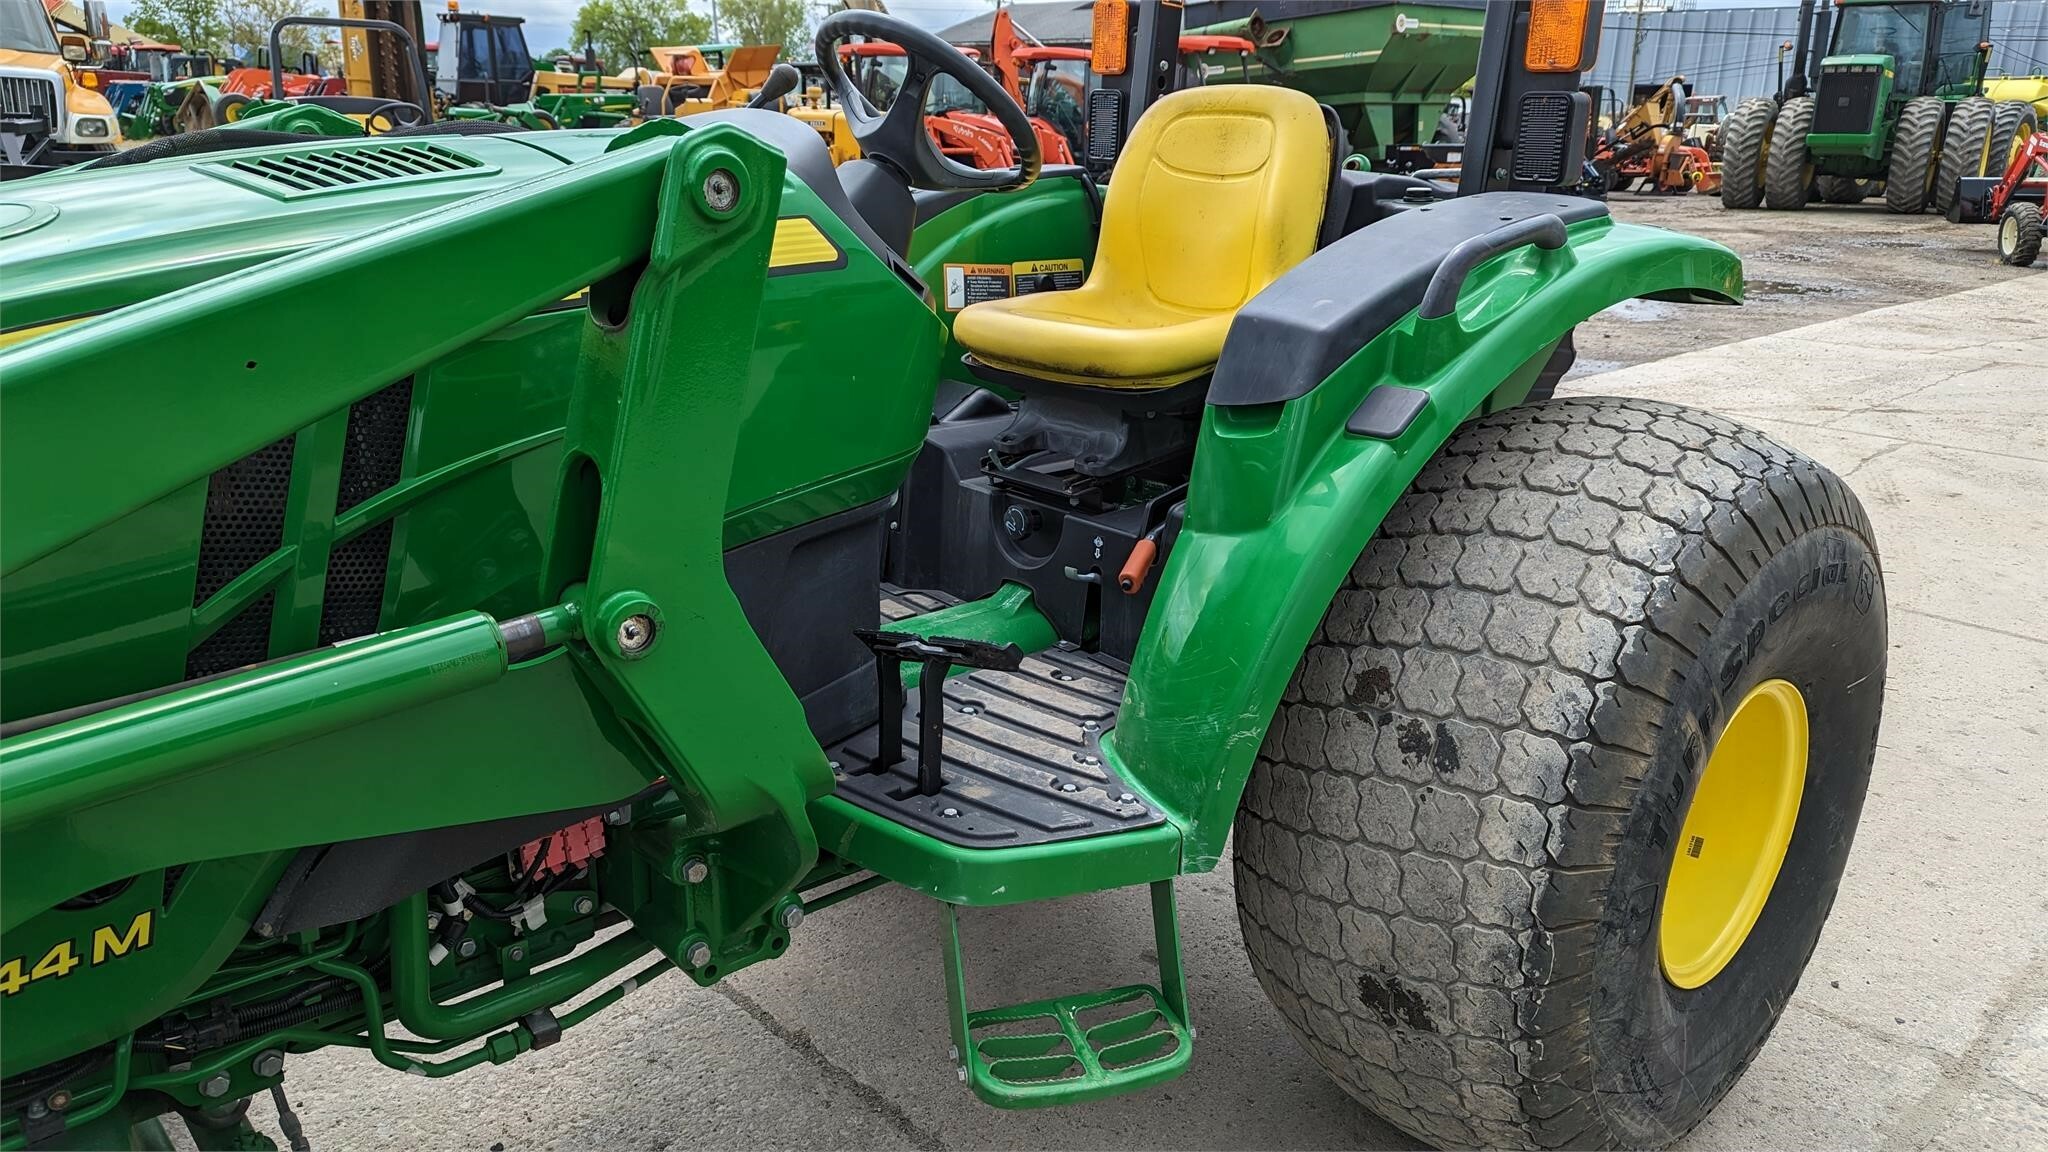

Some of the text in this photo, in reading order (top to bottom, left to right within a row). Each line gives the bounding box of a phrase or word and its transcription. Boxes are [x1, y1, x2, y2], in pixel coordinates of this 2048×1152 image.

[977, 267, 1006, 275] WARNING
[1039, 263, 1069, 273] CAUTION
[0, 910, 152, 995] 44 M
